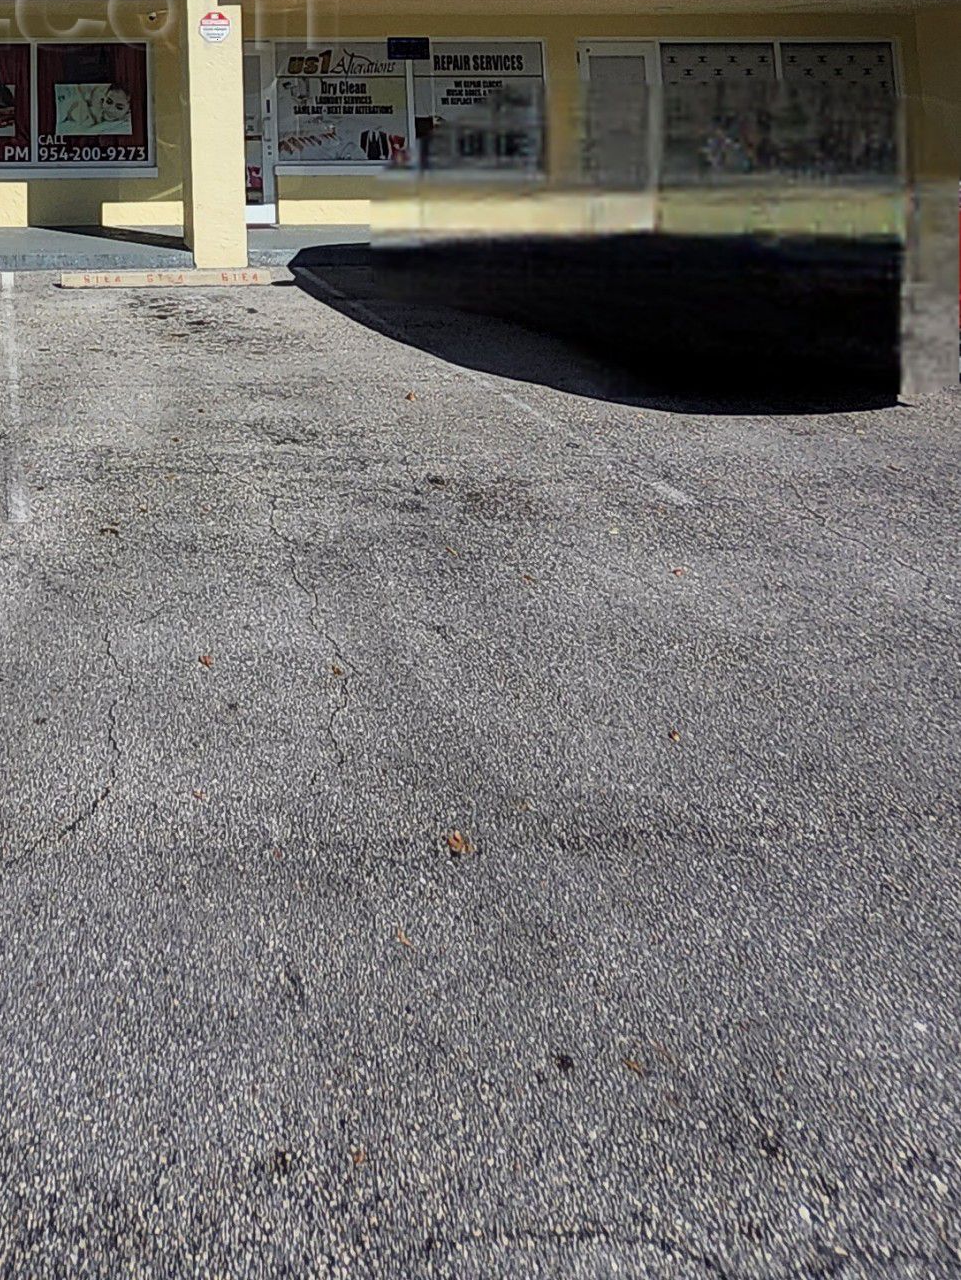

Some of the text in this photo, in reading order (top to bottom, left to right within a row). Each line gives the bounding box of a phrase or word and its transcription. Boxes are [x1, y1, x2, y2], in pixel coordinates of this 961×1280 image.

[433, 55, 523, 71] REPAIR SERVICES
[321, 81, 366, 95] Dry Clean
[38, 134, 67, 145] CALL
[4, 146, 29, 161] PM
[39, 146, 146, 161] 954-200-9273
